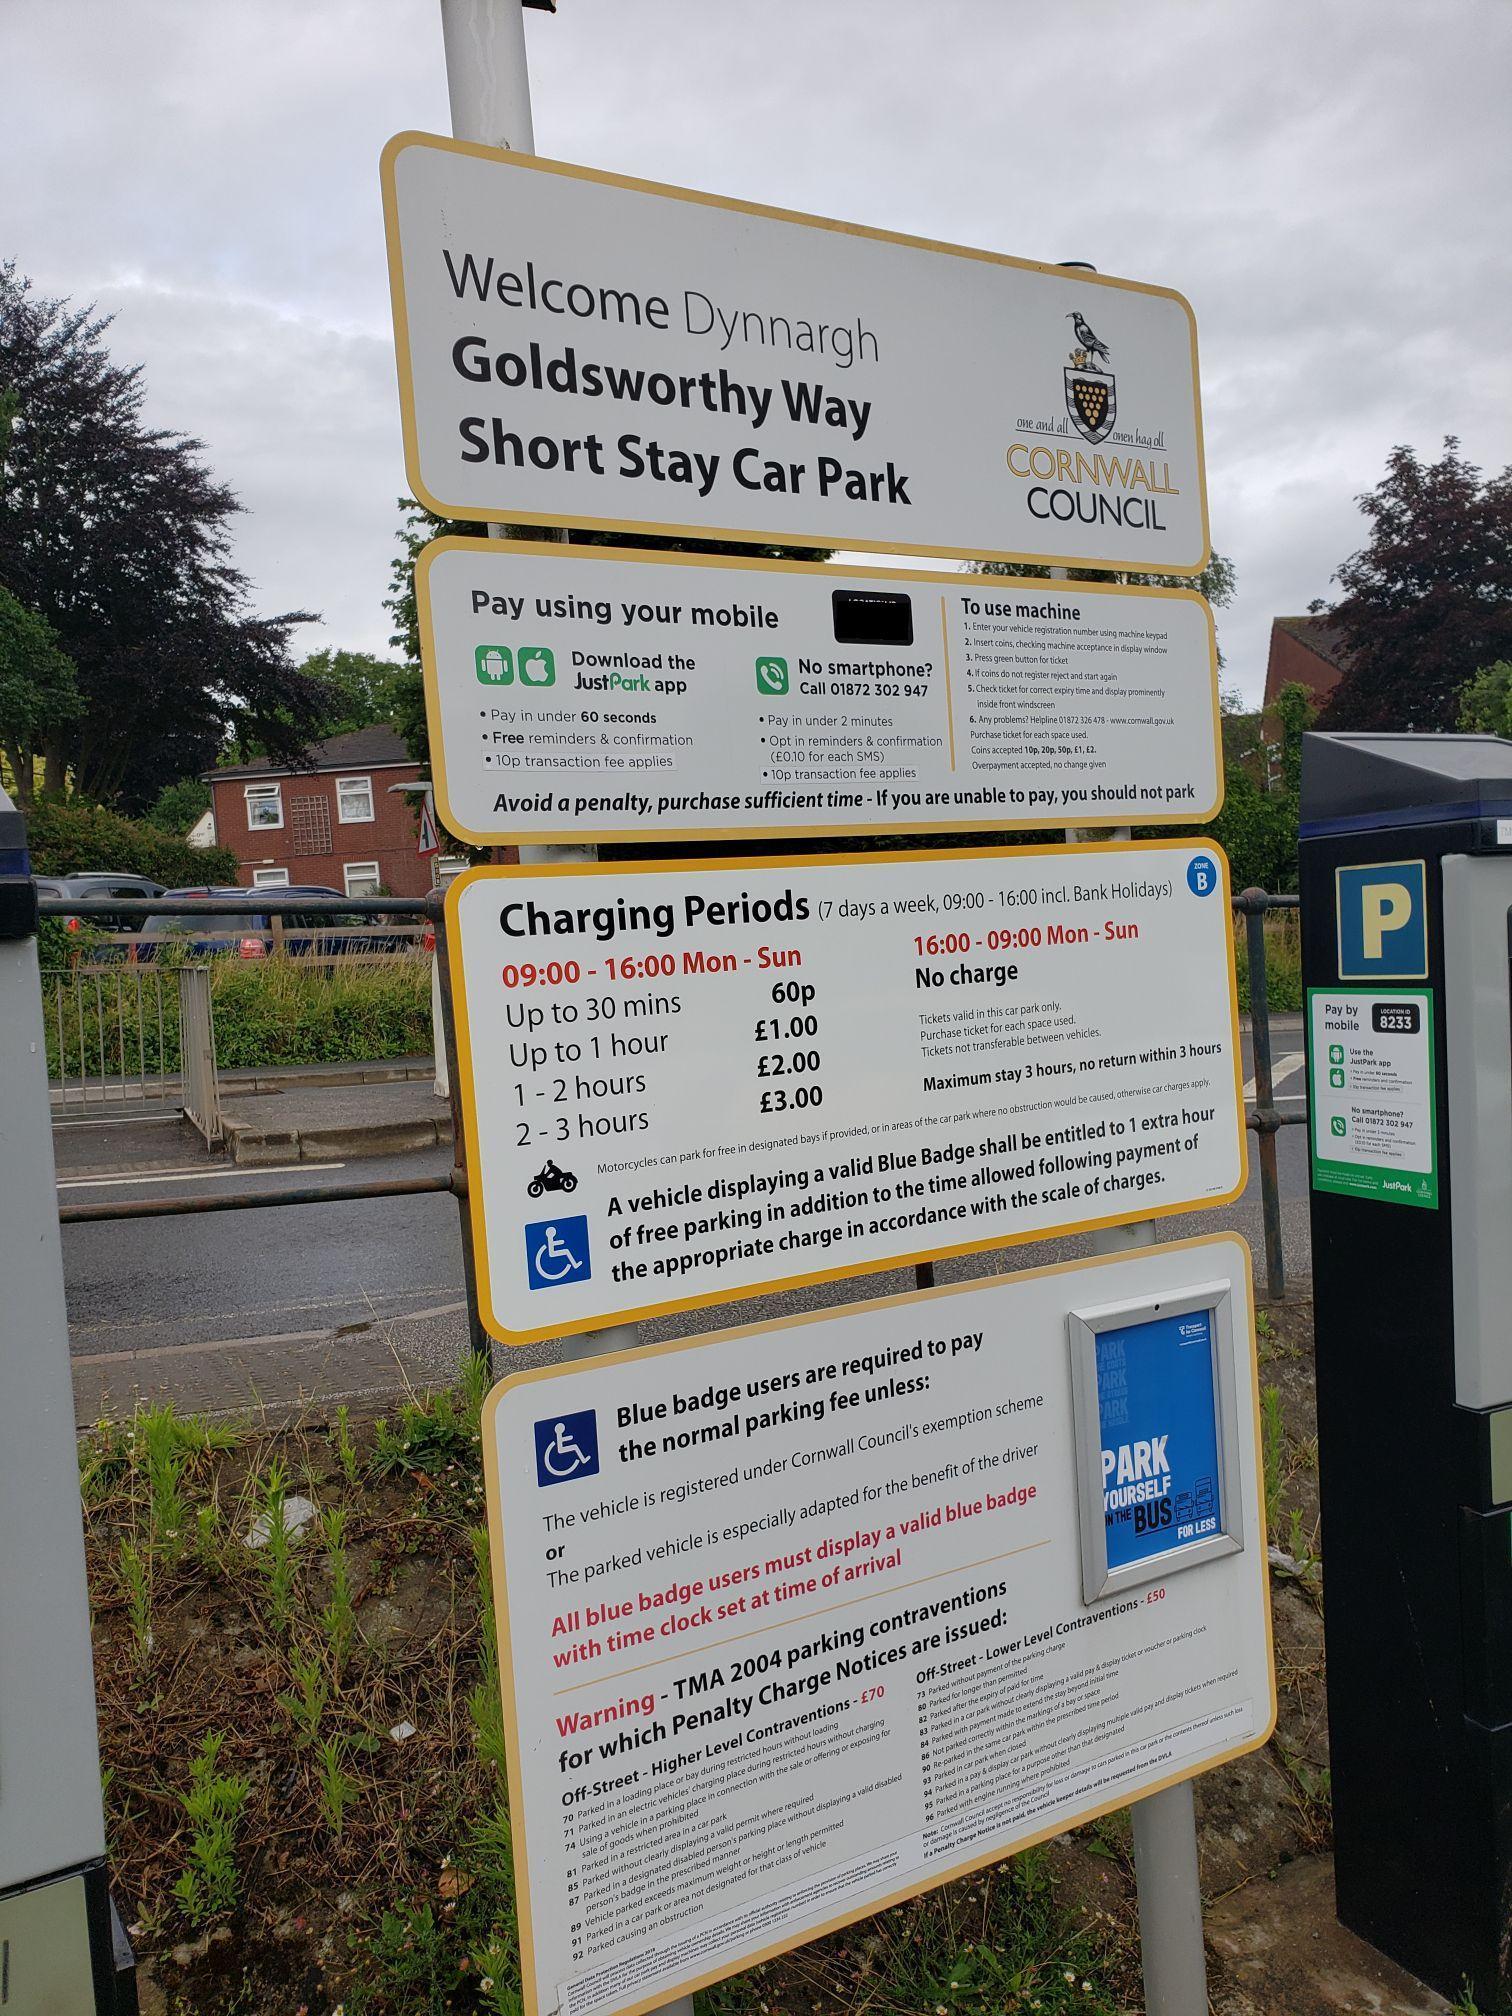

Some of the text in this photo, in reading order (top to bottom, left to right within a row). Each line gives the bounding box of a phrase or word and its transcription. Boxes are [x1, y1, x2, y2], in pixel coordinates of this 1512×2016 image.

[442, 248, 879, 369] Welcome Dynnargh
[452, 336, 871, 440] Goldsworthy Way
[1017, 417, 1068, 433] one and all
[1113, 428, 1164, 450] onen hag oll
[459, 417, 912, 505] Short Stay Car Park
[1006, 443, 1179, 495] CORNWALL
[1027, 486, 1166, 530] COUNCIL
[472, 590, 778, 628] Pay using your mobile
[961, 598, 1080, 620] To use machine
[572, 651, 695, 670] Download the
[799, 659, 932, 678] No smartphone?
[966, 653, 1068, 664] 3. Press green button for ticket
[574, 672, 686, 695] JustPark app
[491, 709, 656, 723] Pay in under 60 seconds
[971, 745, 1096, 755] Coins accepted 10p, 20p, 50p, £1, £2.
[493, 783, 1194, 816] Avoid a penalty, purchase sufficient time If you are unable to pay, you should not park
[1197, 872, 1207, 890] B
[499, 890, 809, 941] Charging Periods
[1362, 883, 1411, 959] P
[502, 947, 801, 988] 09:00 16:00 Mon Sun
[916, 964, 1018, 988] No charge
[772, 981, 815, 1006] 60p
[505, 993, 681, 1032] Up to 30 mins
[918, 1002, 1061, 1024] Tickets valid in this car park only.
[1325, 1004, 1358, 1016] Pay by
[1380, 1015, 1411, 1029] 8233
[755, 1015, 817, 1041] £1.00
[1325, 1020, 1359, 1030] mobile
[757, 1050, 820, 1077] £2.00
[514, 1075, 645, 1106] 1 2 hours
[760, 1086, 822, 1113] £3.00
[1362, 1108, 1403, 1118] smartphone?
[1365, 1117, 1383, 1125] 01872
[1386, 1119, 1398, 1127] 302
[1382, 1180, 1411, 1192] JustPark
[617, 1332, 983, 1427] Blue badge users are required to pay
[1101, 1435, 1169, 1488] PARK
[1116, 1508, 1131, 1522] THE
[1134, 1498, 1172, 1533] BUS
[1177, 1517, 1215, 1539] FOR LESS
[546, 1545, 564, 1560] or
[556, 1581, 1006, 1737] Warning TMA 2004 parking contraventions
[917, 1642, 1066, 1699] 73 Parked without payment of the parking charge
[562, 1686, 884, 1806] Off-Street Higher Level Contraventions £70
[567, 1868, 576, 1877] 81
[581, 1855, 608, 1872] Parked
[626, 1835, 662, 1855] restricted
[665, 1831, 680, 1841] area
[697, 1820, 708, 1830] car
[711, 1814, 727, 1826] park
